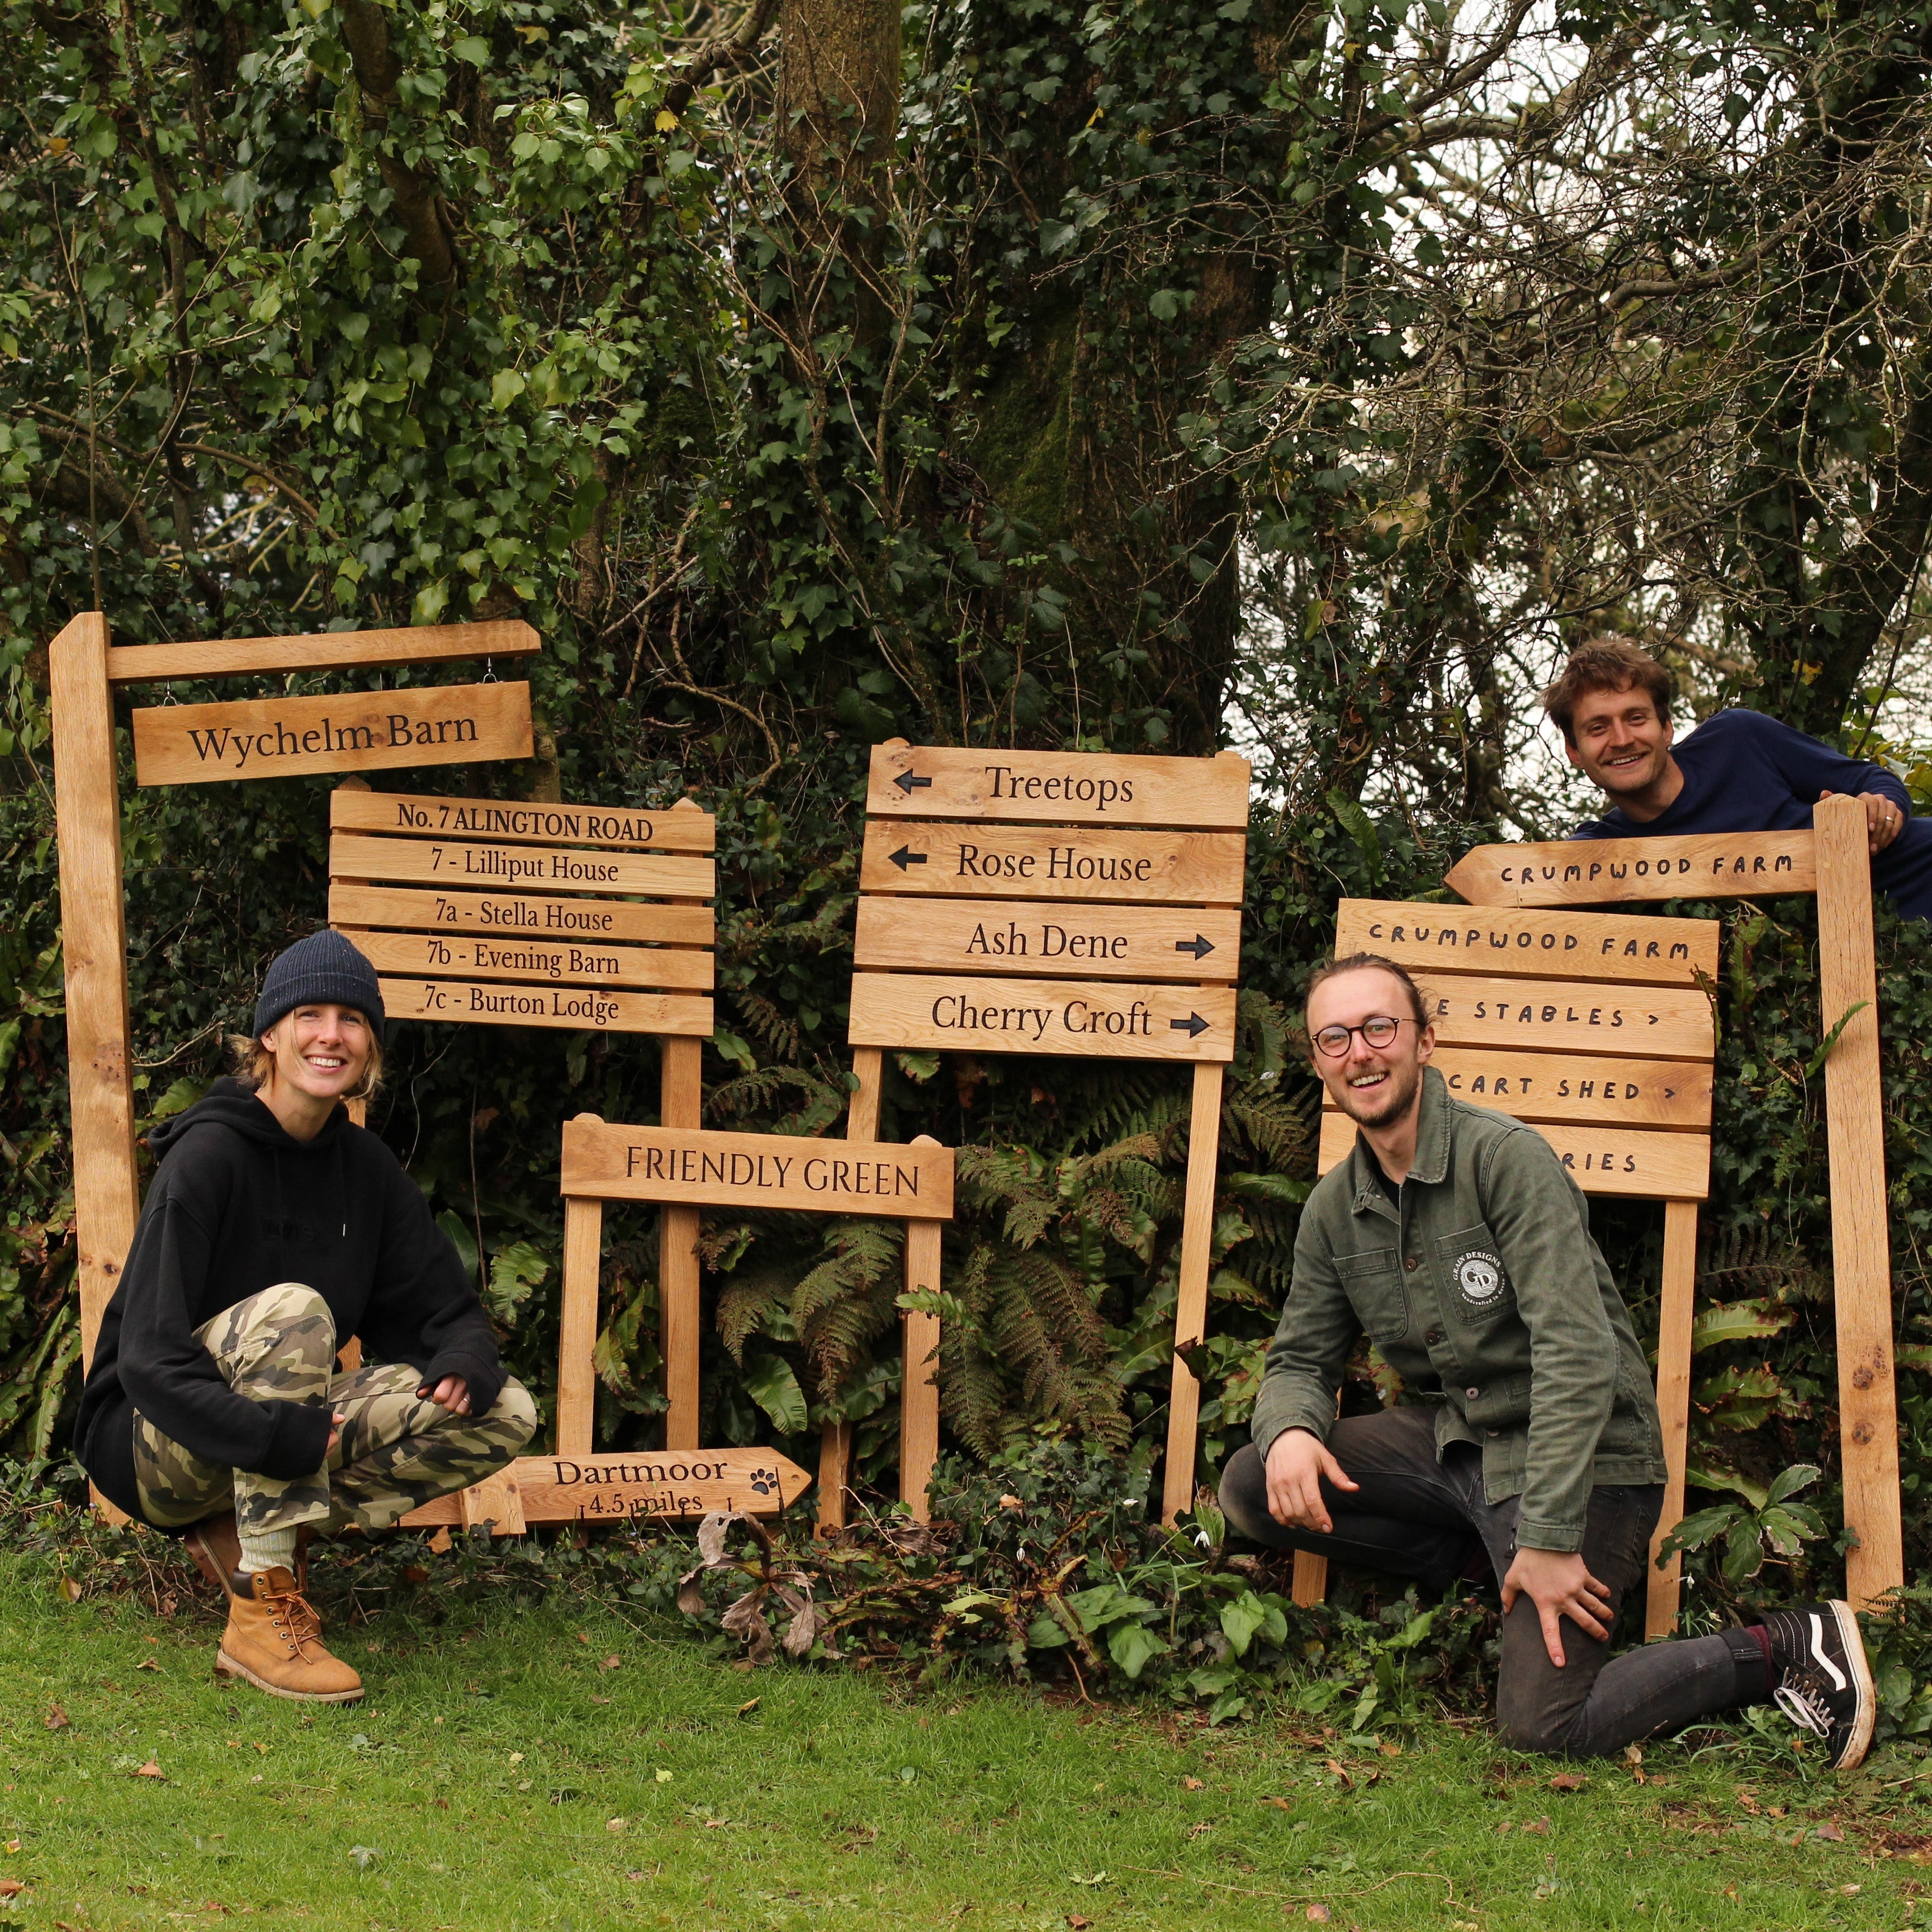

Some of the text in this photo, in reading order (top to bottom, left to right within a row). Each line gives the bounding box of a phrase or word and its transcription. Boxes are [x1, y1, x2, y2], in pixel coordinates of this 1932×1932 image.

[187, 714, 479, 769] Wychelm Barn
[985, 766, 1133, 811] Treetops
[396, 803, 653, 841] No. 7 ALINGTON ROAD
[432, 846, 443, 871] 7
[465, 850, 544, 882] Lilliput
[551, 855, 618, 882] House
[956, 844, 1152, 881] Rose House
[1501, 855, 1792, 884] CRUMPWOOD FARM
[435, 897, 458, 922] 7a
[480, 901, 539, 927] Stella
[545, 905, 613, 931] House
[427, 939, 451, 965] 7b
[474, 944, 563, 978] Evening
[569, 949, 620, 974] Barn
[965, 922, 1128, 959] Ash Dene
[1369, 924, 1688, 960] CRUMPWOOD FARM
[425, 984, 447, 1009] 7c
[469, 987, 545, 1015] Burton
[552, 992, 619, 1025] Lodge
[932, 995, 1152, 1041] Cherry Croft
[1474, 1001, 1623, 1027] STABLES
[1448, 1074, 1639, 1100] CART SHED
[627, 1146, 919, 1197] FRIENDLY GREEN
[1561, 1153, 1636, 1172] RIES
[1453, 1252, 1501, 1280] GRAIN DESIGNS
[552, 1461, 728, 1485] Dartmoor
[589, 1490, 703, 1514] 4.5 miles
